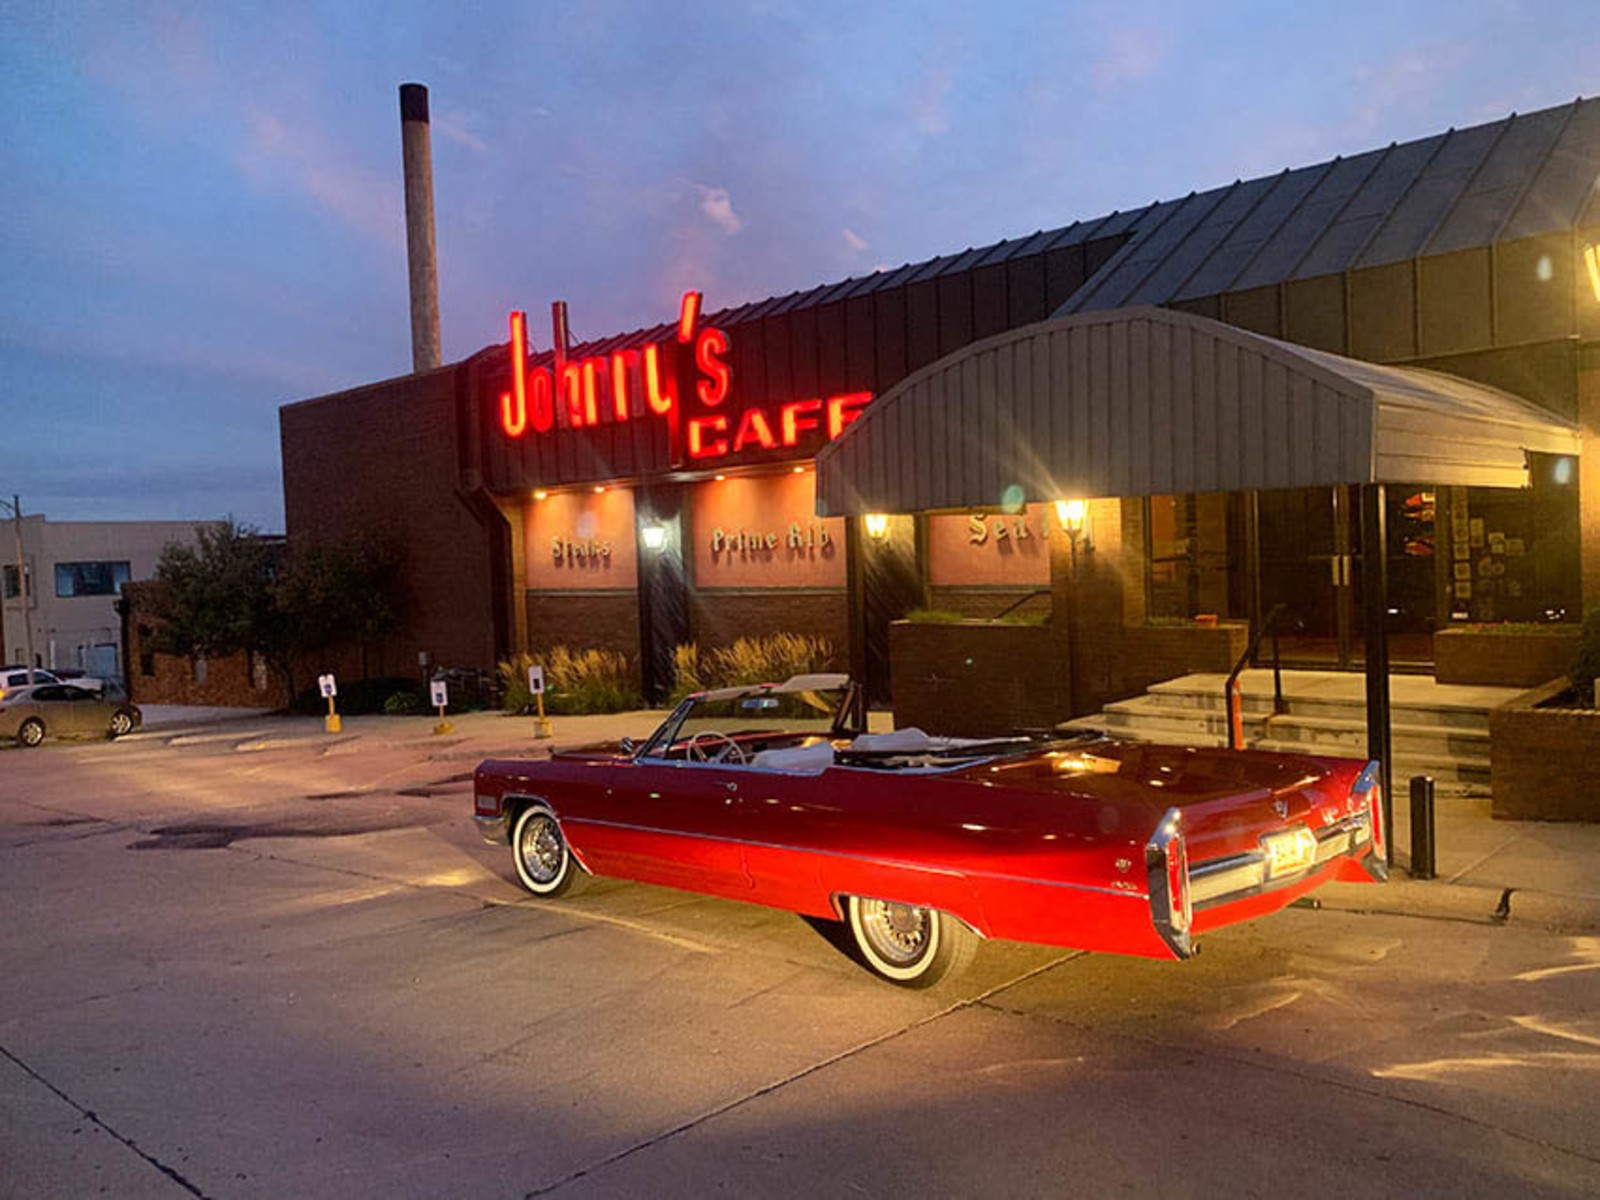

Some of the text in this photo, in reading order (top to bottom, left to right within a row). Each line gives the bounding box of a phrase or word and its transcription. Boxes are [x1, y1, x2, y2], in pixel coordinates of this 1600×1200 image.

[500, 290, 732, 468] Johnny's
[712, 521, 833, 553] Prime Rib
